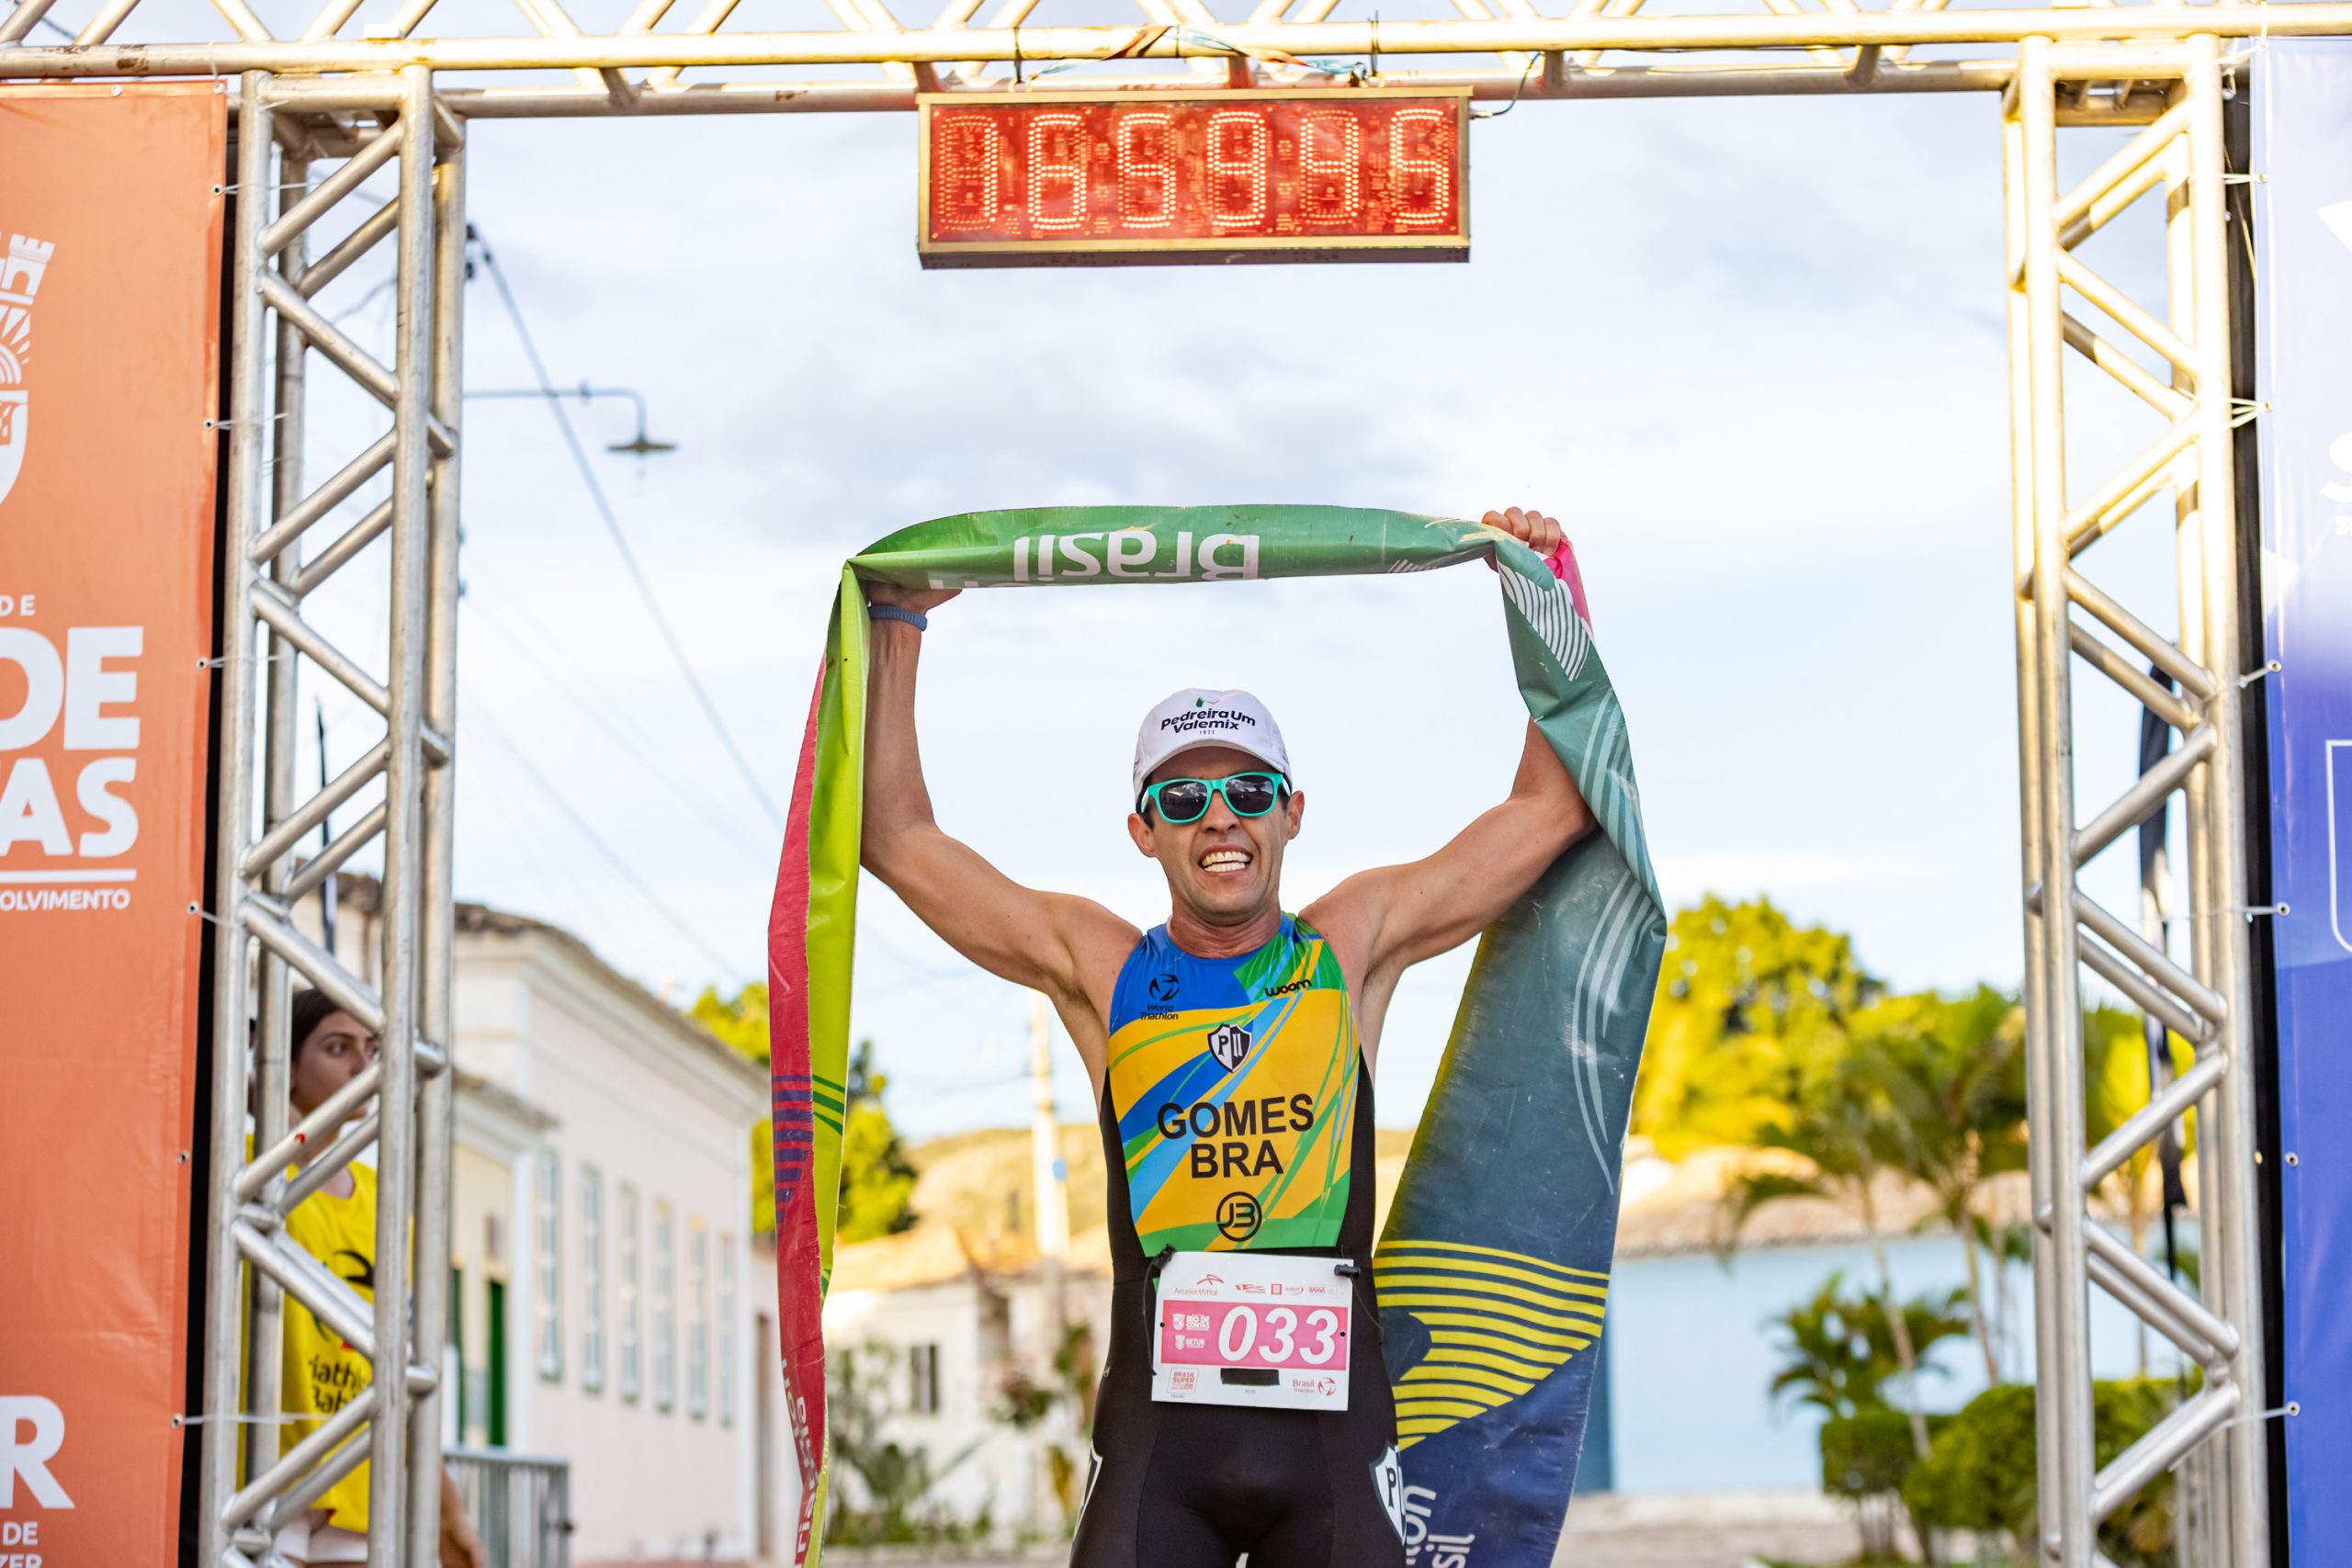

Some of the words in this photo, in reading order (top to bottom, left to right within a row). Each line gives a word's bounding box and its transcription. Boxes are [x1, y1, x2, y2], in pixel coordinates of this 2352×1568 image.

[1012, 529, 1260, 582] Brasil
[1160, 708, 1229, 731] Pedreira
[1230, 710, 1256, 727] Um
[1173, 718, 1239, 733] Valemix
[0, 756, 140, 858] AS
[0, 887, 131, 912] OLVIMENTO
[1264, 979, 1312, 998] woom
[1139, 1011, 1179, 1021] Triathlon
[1147, 1003, 1174, 1012] World
[1157, 1093, 1315, 1140] GOMES
[1191, 1139, 1284, 1179] BRA
[1218, 1305, 1339, 1366] 033
[1293, 1379, 1315, 1388] Brasil
[3, 1521, 39, 1546] DE
